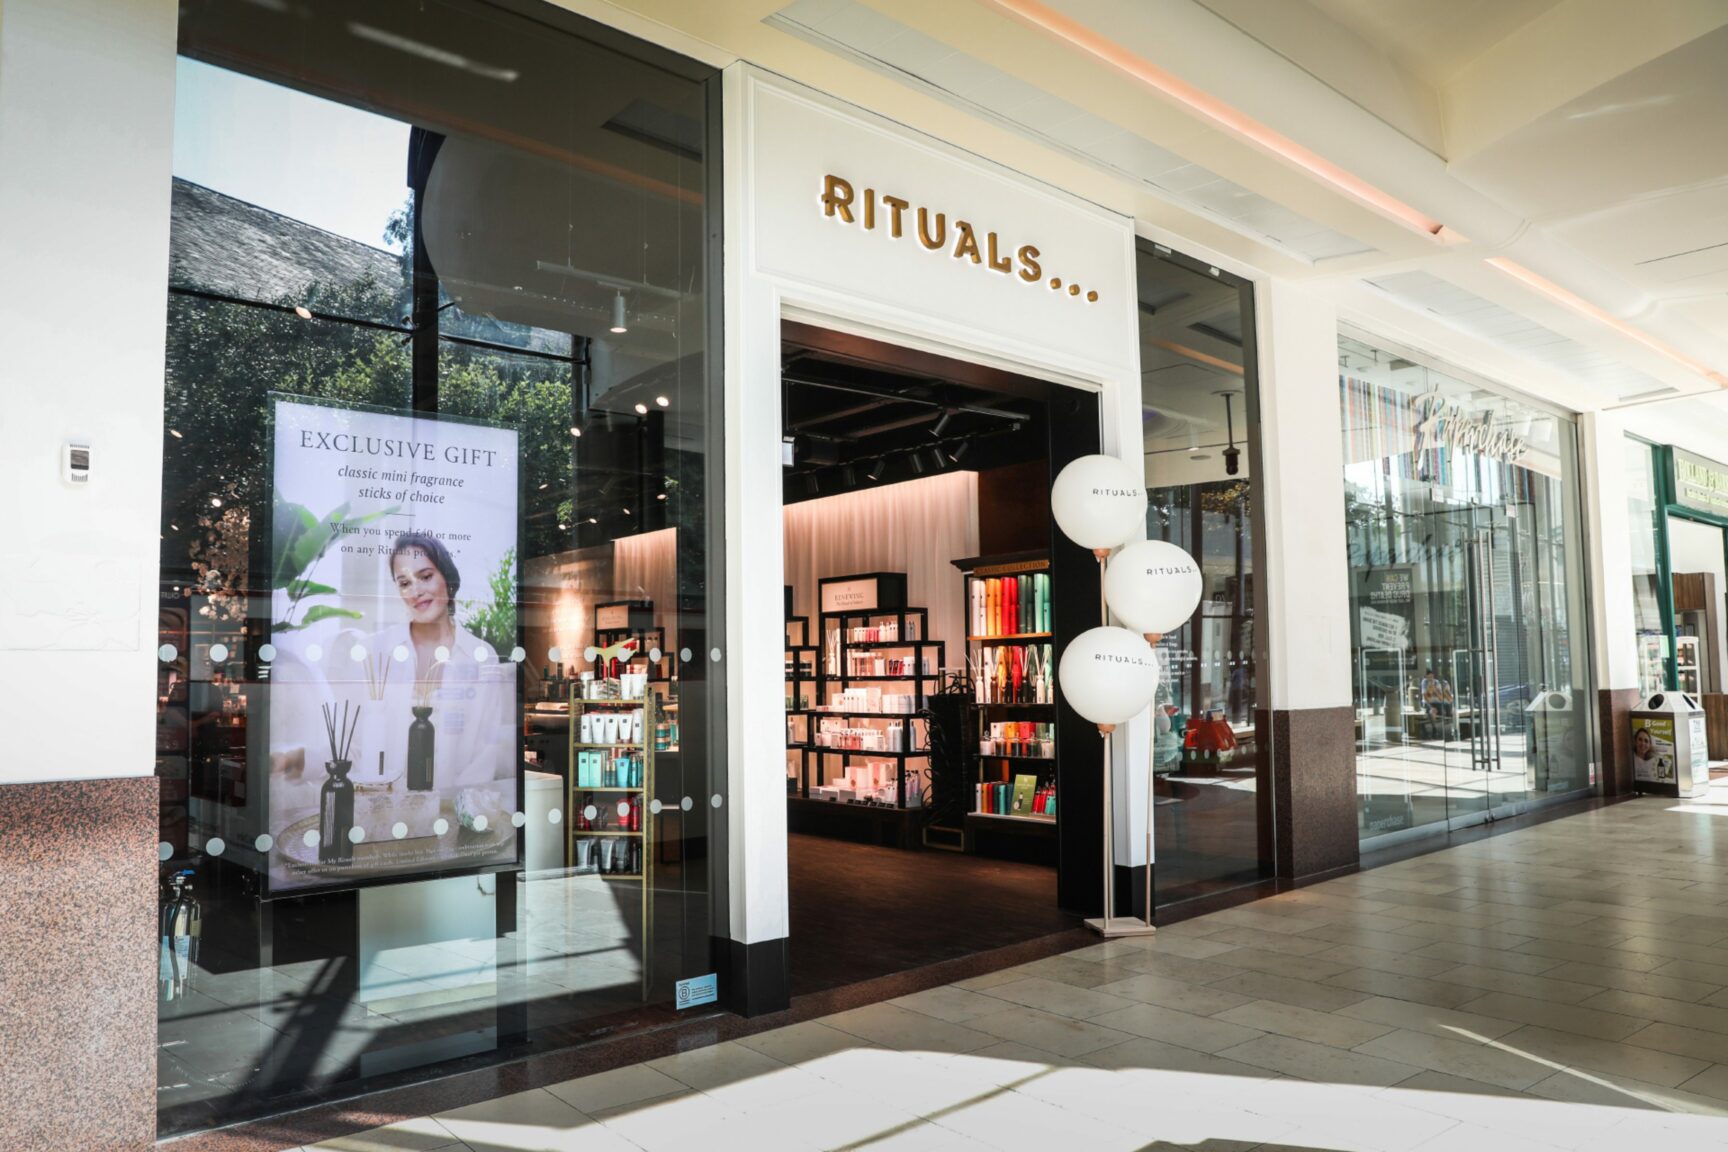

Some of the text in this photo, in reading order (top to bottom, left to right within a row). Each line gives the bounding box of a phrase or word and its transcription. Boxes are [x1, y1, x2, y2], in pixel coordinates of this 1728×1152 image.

[821, 174, 1099, 303] RITUALS...
[300, 430, 497, 467] EXCLUSIVE GIFT
[338, 465, 464, 488] classic mini fragrance
[358, 487, 445, 504] sticks of choice
[330, 522, 360, 535] When
[363, 527, 381, 537] you
[384, 528, 412, 539] spend
[435, 532, 446, 540] or
[448, 533, 472, 541] more
[340, 545, 353, 553] on
[356, 546, 375, 557] any
